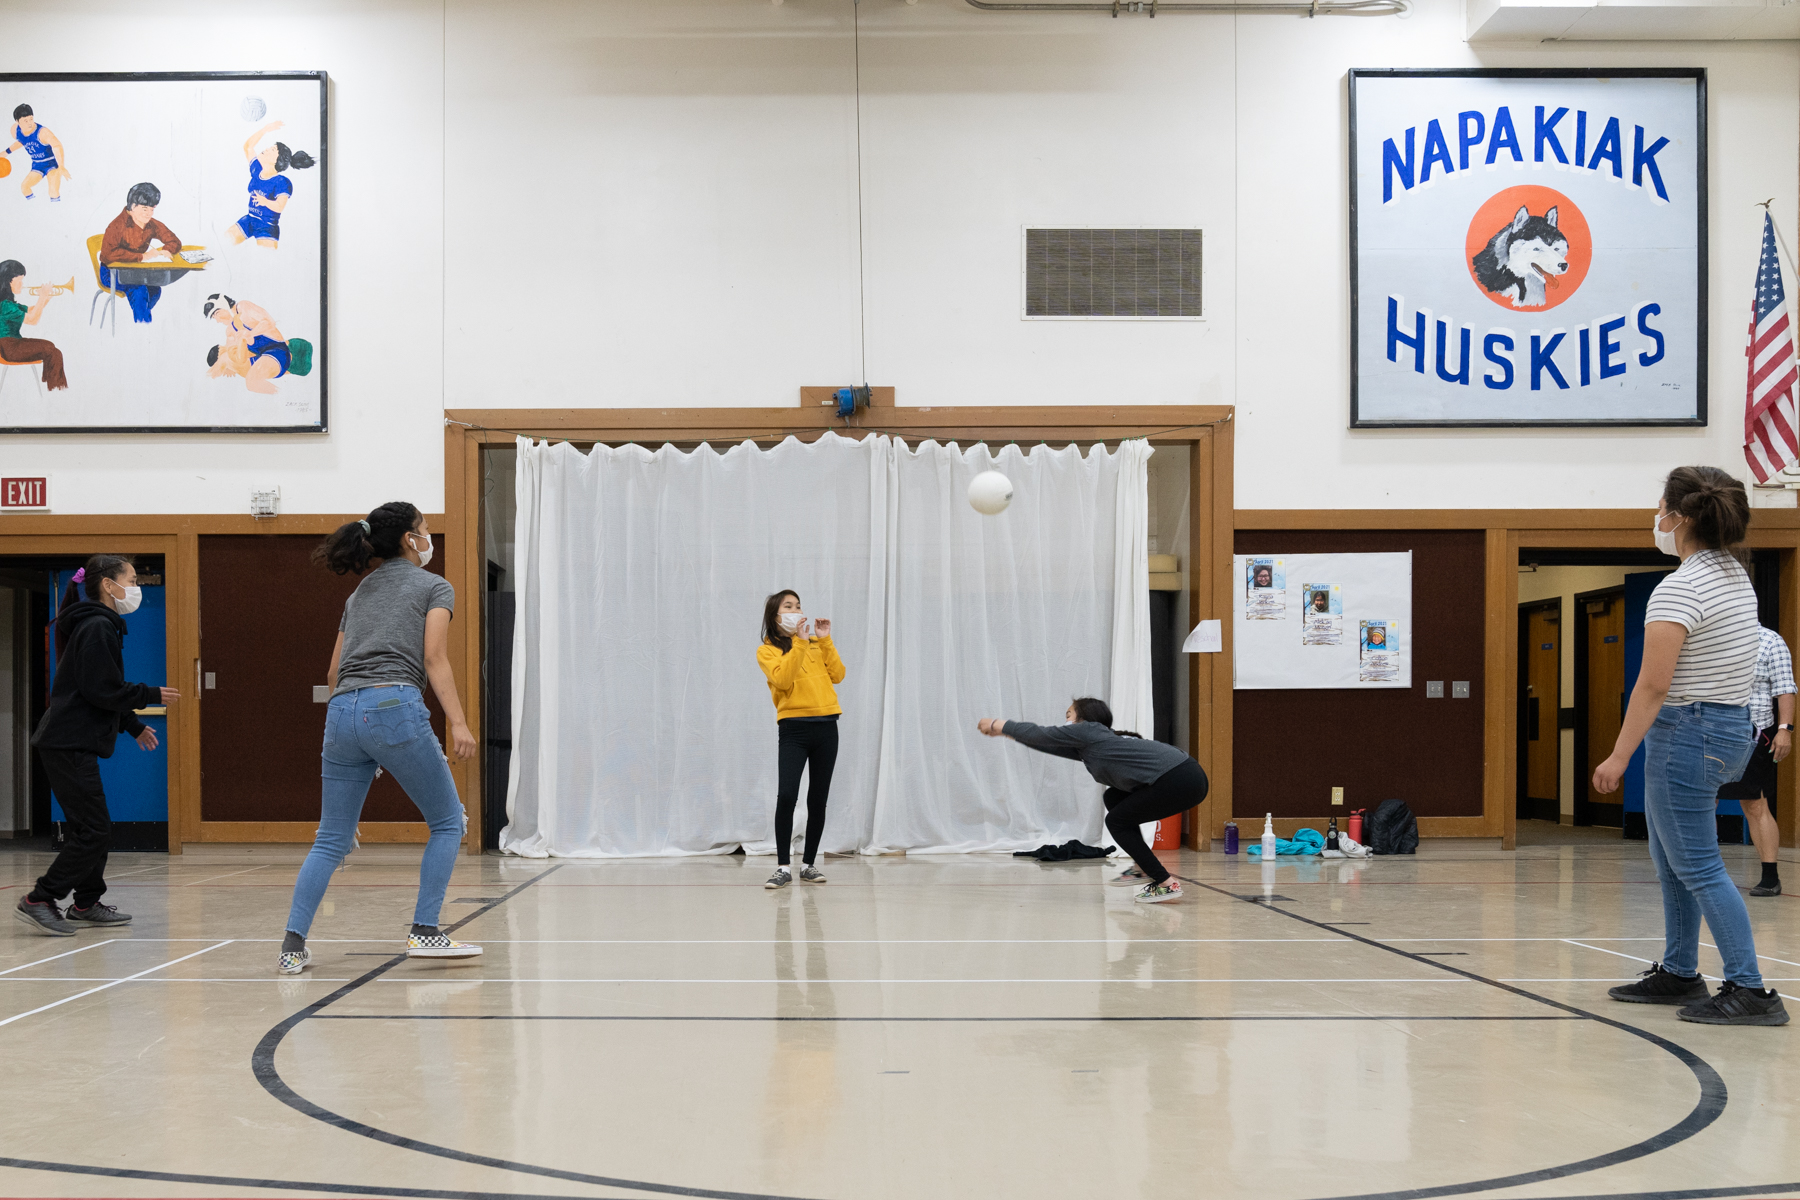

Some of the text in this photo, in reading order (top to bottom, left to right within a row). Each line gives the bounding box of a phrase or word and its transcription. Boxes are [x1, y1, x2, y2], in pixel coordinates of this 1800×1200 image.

[1382, 105, 1671, 205] NAPAKIAK
[1386, 295, 1666, 391] HUSKIES
[8, 481, 42, 505] EXIT
